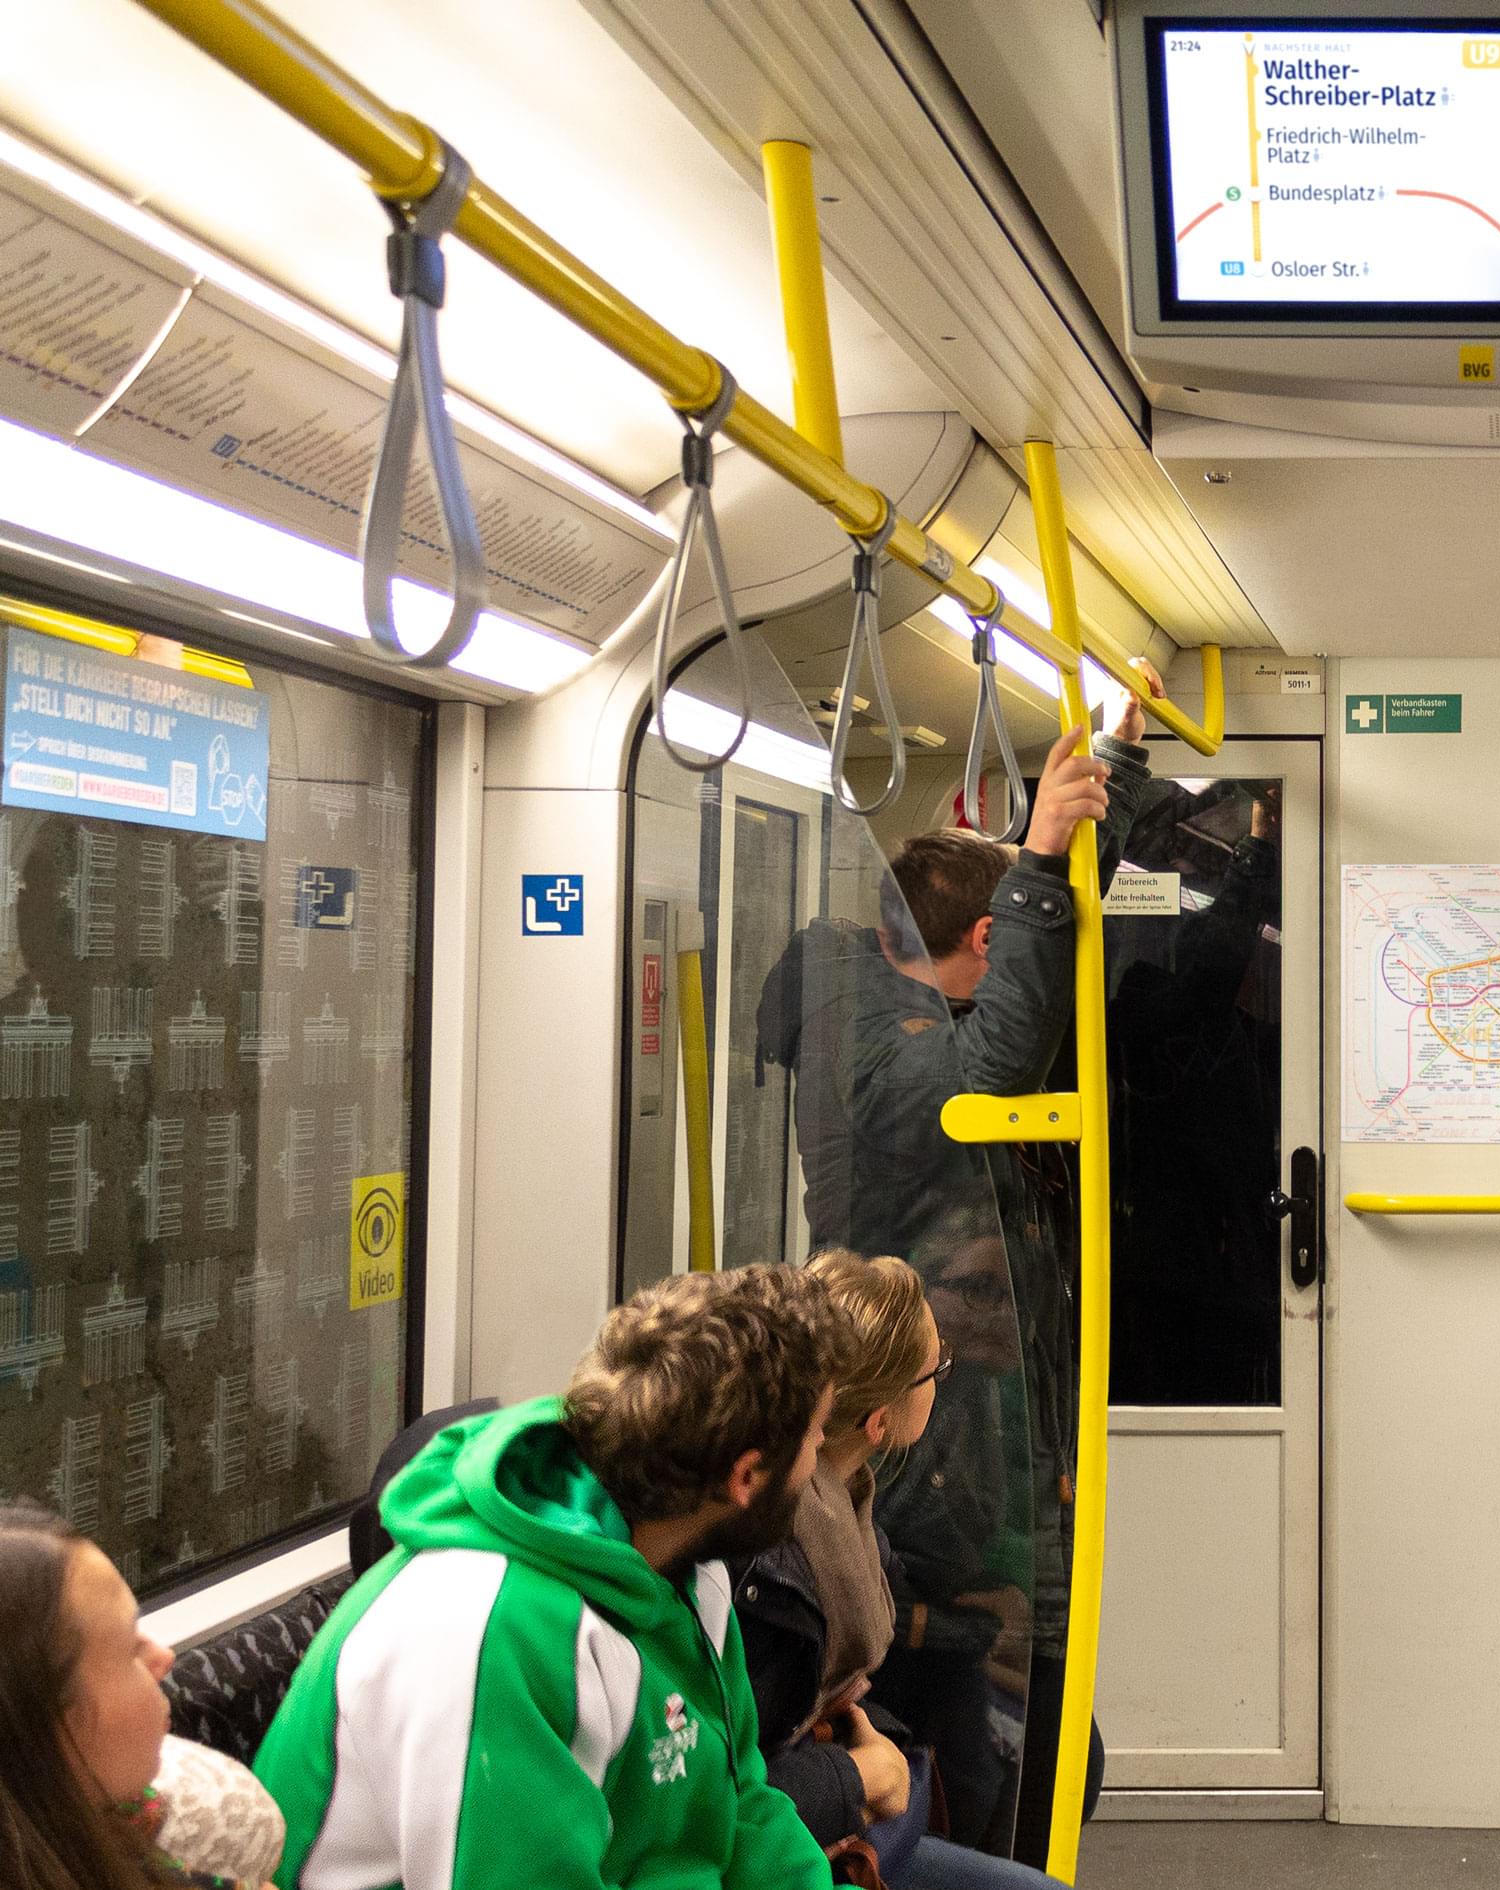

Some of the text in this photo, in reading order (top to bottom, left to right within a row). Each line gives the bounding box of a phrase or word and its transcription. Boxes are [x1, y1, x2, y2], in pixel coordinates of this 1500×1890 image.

[1170, 40, 1201, 52] 21:24
[1324, 43, 1351, 53] HALT
[1469, 43, 1500, 64] U9
[1264, 59, 1359, 80] Walther-
[1265, 85, 1436, 107] Schreiber-Platz
[1266, 127, 1426, 145] Friedrich-Wilhelm-
[1267, 147, 1310, 164] Platz
[1269, 185, 1375, 204] Bundesplatz
[1223, 262, 1241, 274] U8
[1271, 261, 1359, 277] Osloer Str.
[1463, 363, 1490, 378] BVG
[1391, 697, 1447, 708] Verbandkasten
[64, 692, 93, 724] DICH
[96, 700, 133, 733] NICHT
[134, 707, 151, 737] SO
[1391, 707, 1435, 717] beim Fahrer
[1118, 877, 1158, 886] Türbereich
[1110, 893, 1165, 902] bitte freihalten
[359, 1269, 395, 1299] Video
